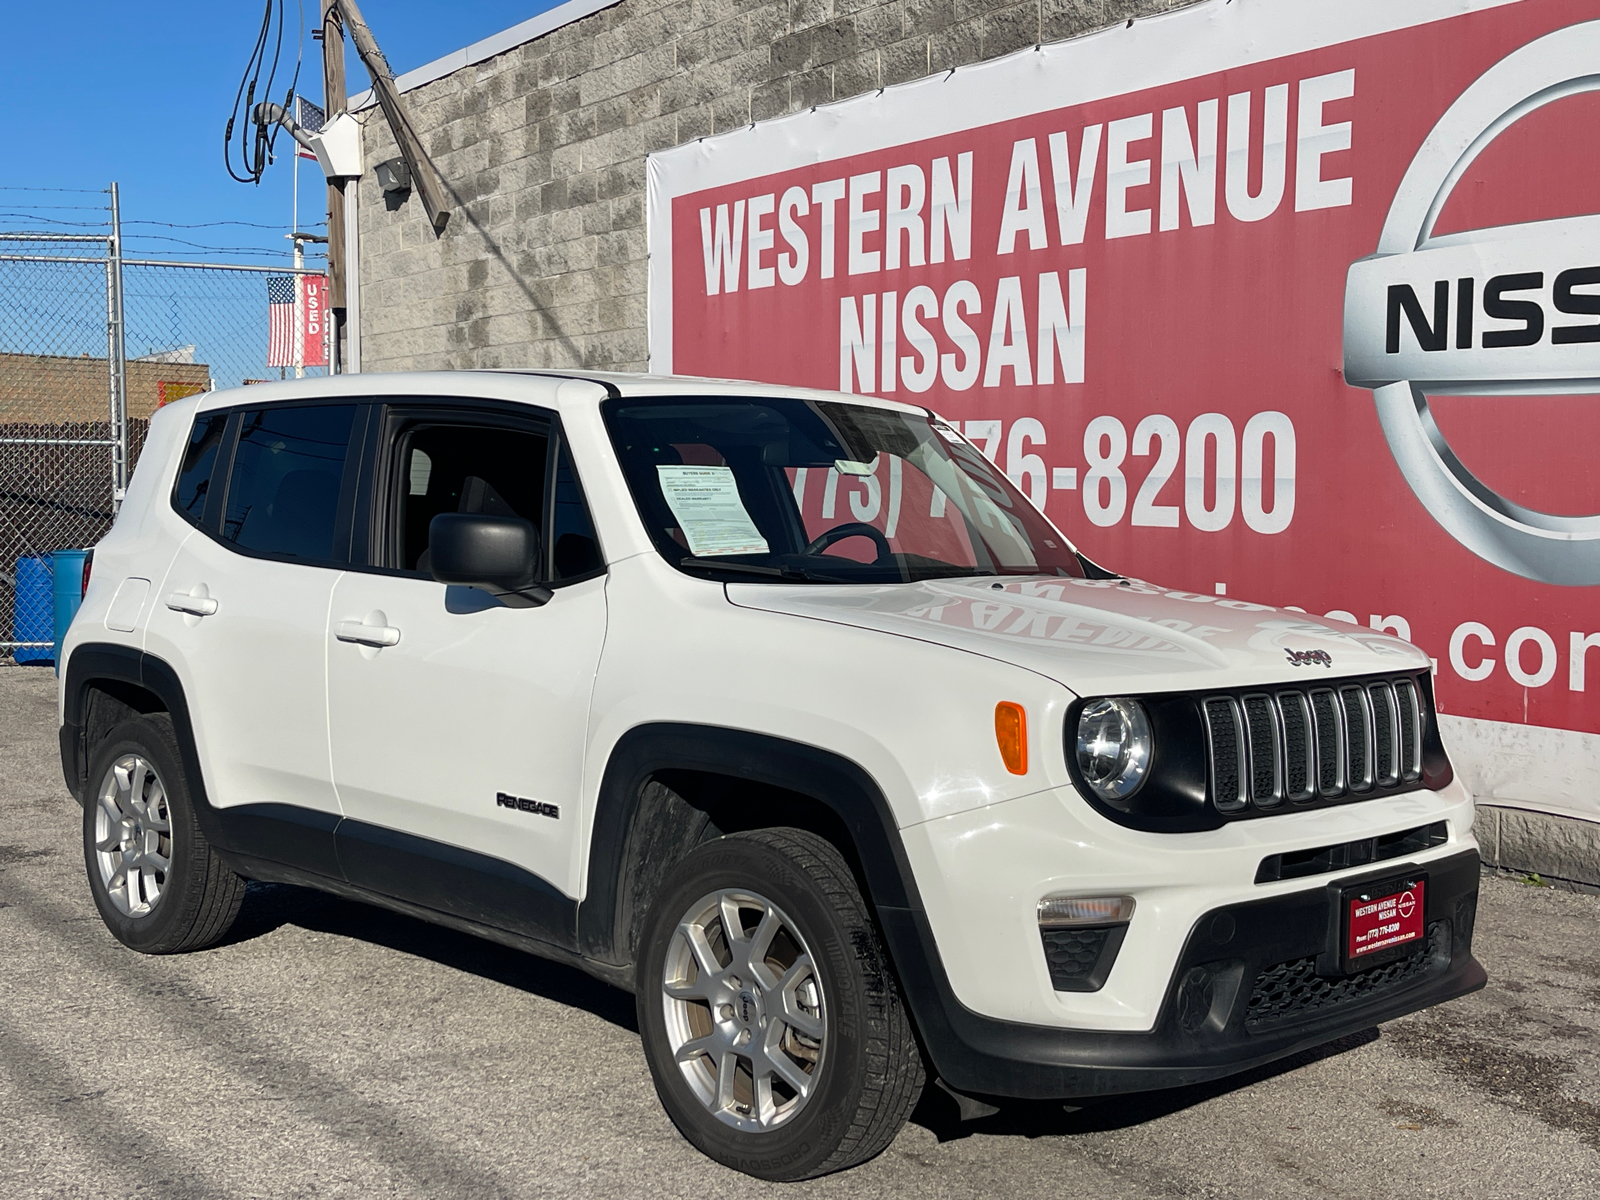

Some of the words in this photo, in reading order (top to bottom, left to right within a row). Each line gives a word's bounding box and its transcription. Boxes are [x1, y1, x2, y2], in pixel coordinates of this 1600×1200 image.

[700, 150, 973, 296] WESTERN
[997, 68, 1356, 256] AVENUE
[307, 284, 320, 334] USED
[839, 268, 1087, 393] NISSAN
[1284, 648, 1332, 668] Jeep
[496, 792, 560, 819] RENEGADE
[1355, 904, 1378, 917] WESTERN
[1378, 898, 1397, 911] AVENUE
[1398, 900, 1416, 908] NISSAN
[1379, 908, 1397, 921] NISSAN
[1368, 928, 1379, 941] (773)
[1380, 922, 1400, 936] 776-8200
